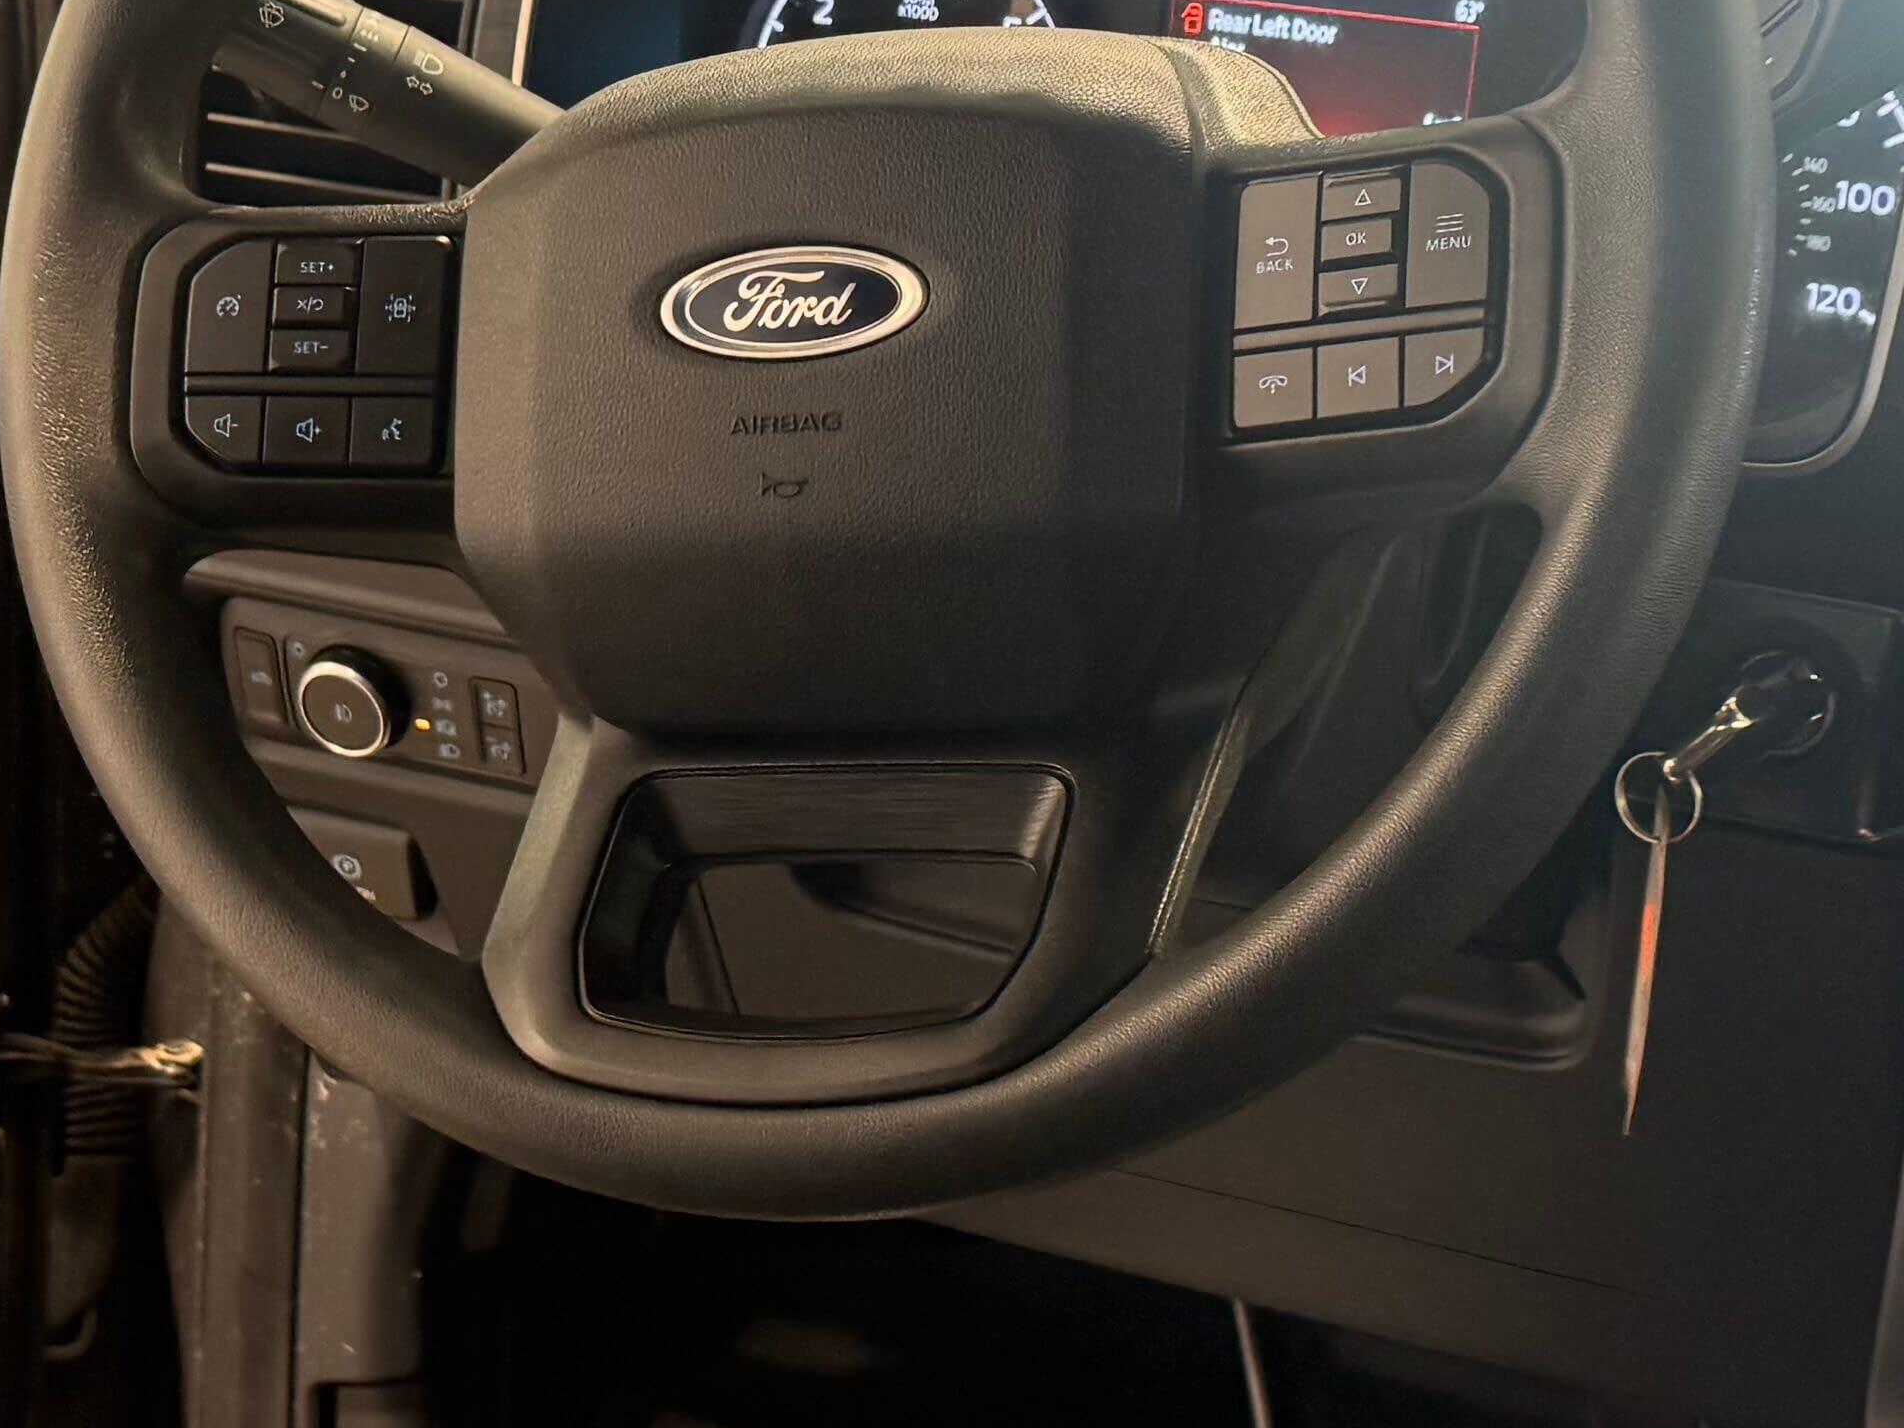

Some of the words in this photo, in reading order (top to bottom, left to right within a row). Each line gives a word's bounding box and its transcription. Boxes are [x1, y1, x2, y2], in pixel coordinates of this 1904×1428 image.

[1207, 7, 1252, 35] Rear
[1252, 14, 1290, 40] Left
[1291, 18, 1339, 46] Door
[1835, 180, 1896, 216] 100
[1345, 231, 1367, 246] OK
[1424, 235, 1473, 253] MENU
[1255, 259, 1294, 275] BACK
[723, 270, 856, 332] Ford
[1806, 281, 1862, 317] 120
[730, 412, 845, 436] AIRBAG
